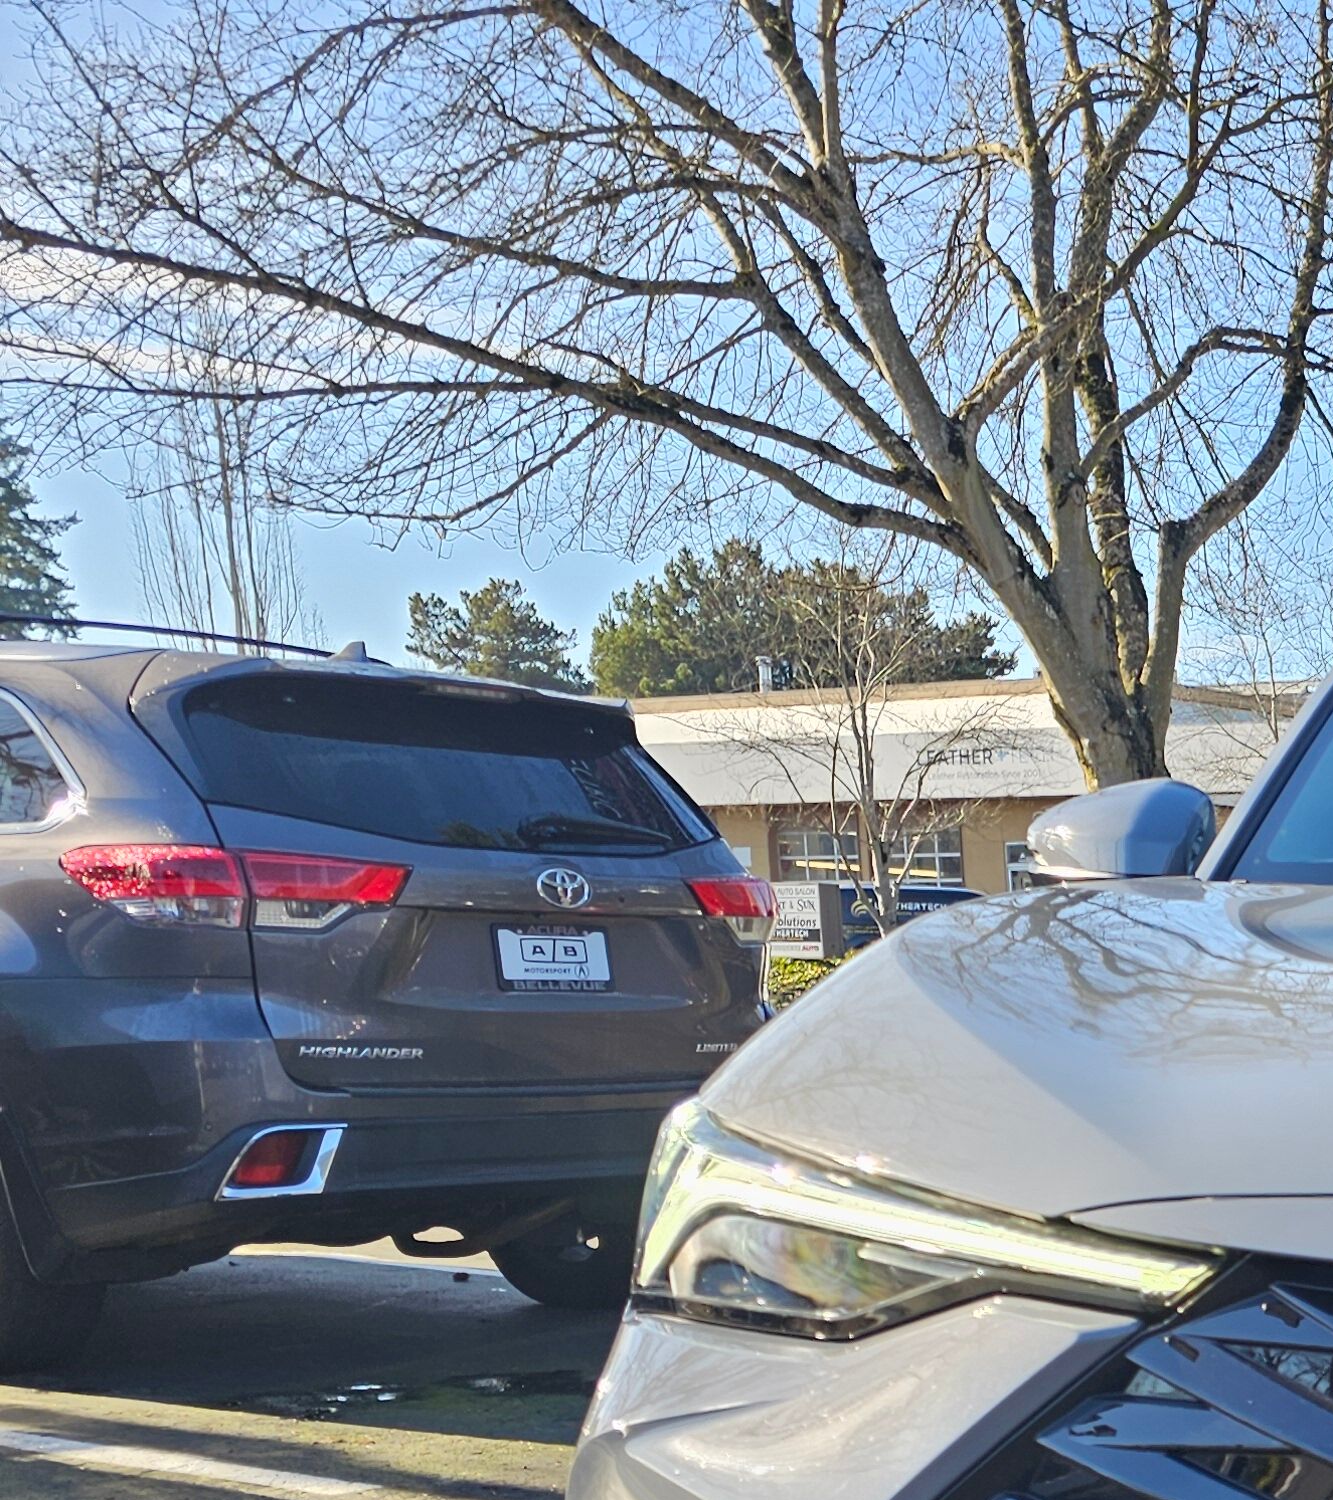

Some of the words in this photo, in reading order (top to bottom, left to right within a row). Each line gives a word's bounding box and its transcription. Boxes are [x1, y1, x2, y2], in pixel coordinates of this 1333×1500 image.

[795, 887, 815, 895] SALON
[778, 914, 816, 927] olutions
[527, 925, 578, 935] ACURA
[532, 945, 546, 956] A
[563, 946, 577, 956] B
[513, 980, 606, 991] BELLEVUE
[299, 1045, 424, 1059] HIGHLANDER
